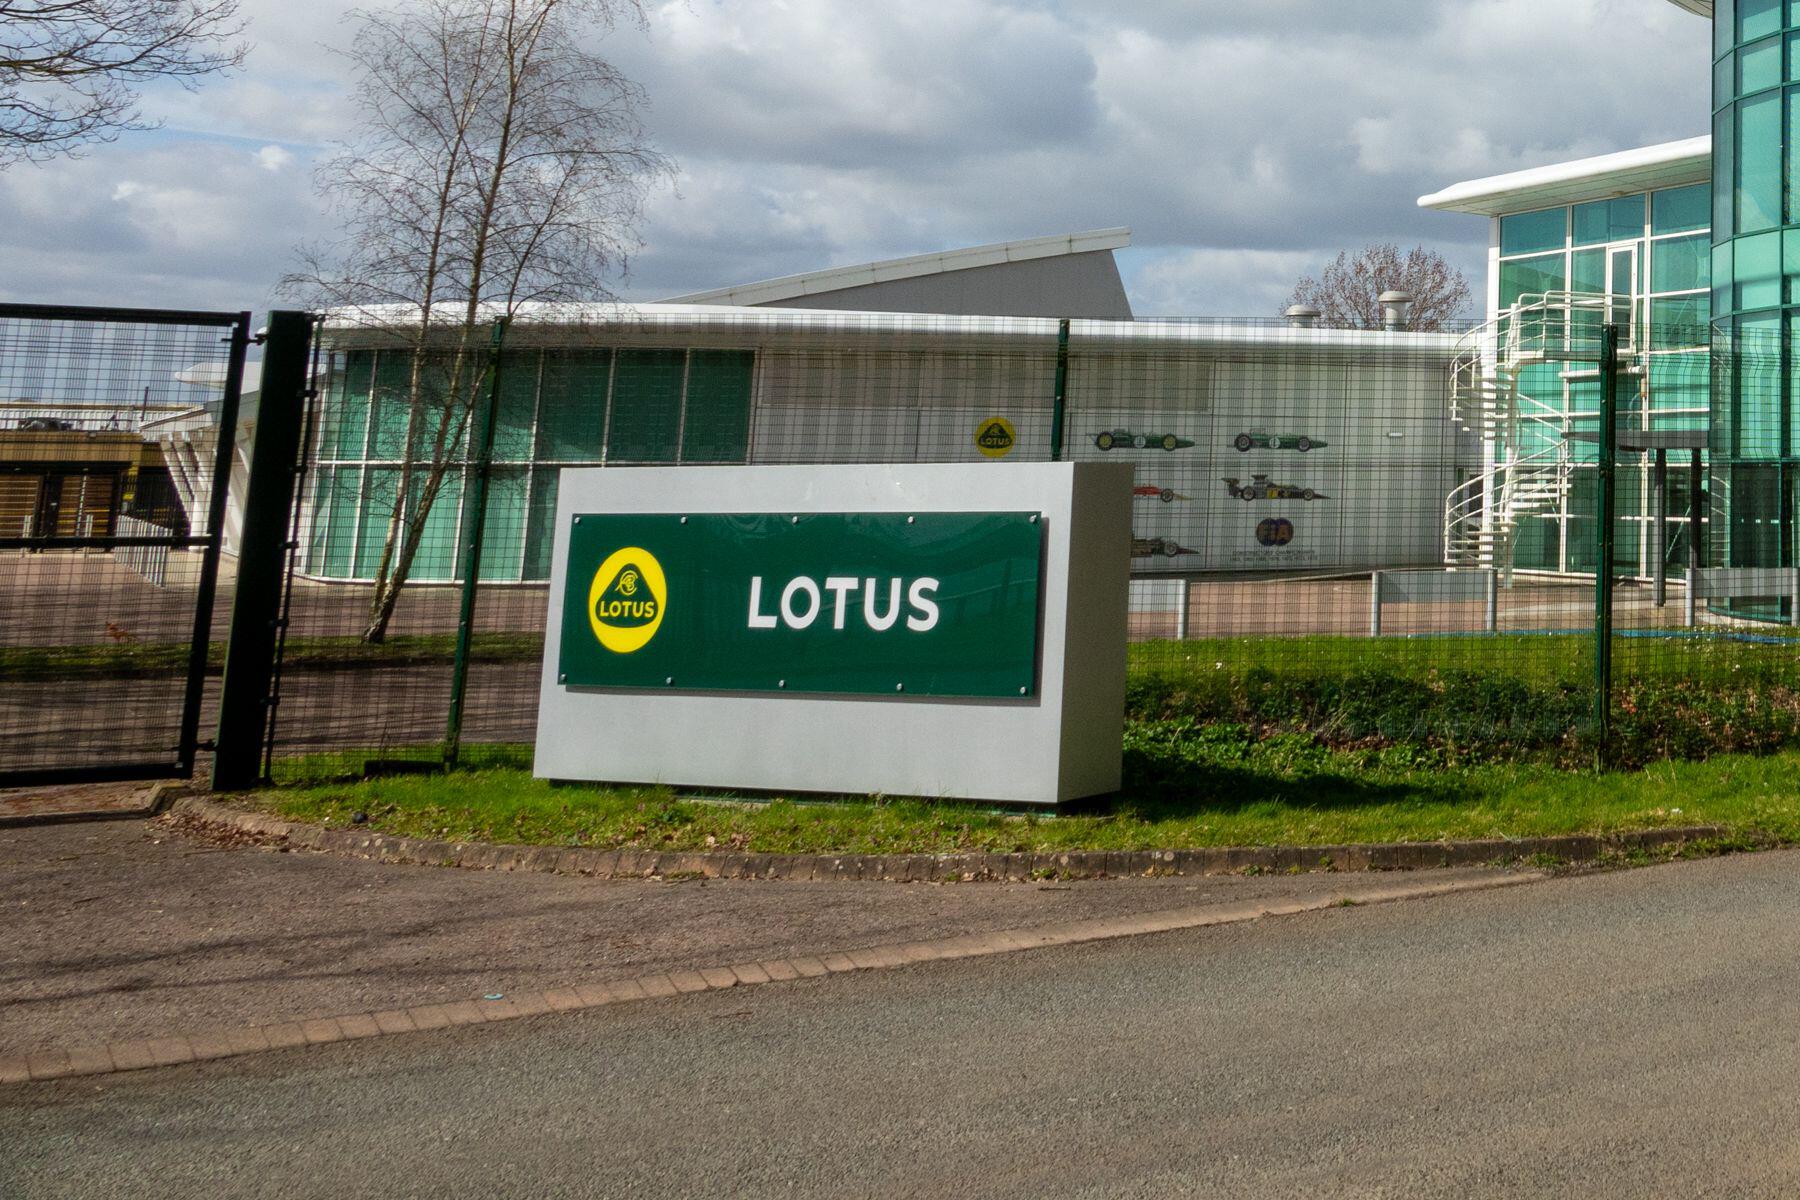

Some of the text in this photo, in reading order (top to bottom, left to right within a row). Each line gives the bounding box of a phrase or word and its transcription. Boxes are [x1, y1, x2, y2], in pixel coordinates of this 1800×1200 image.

[980, 437, 1010, 446] LOTUS
[600, 600, 655, 618] LOTUS
[748, 575, 940, 632] LOTUS
